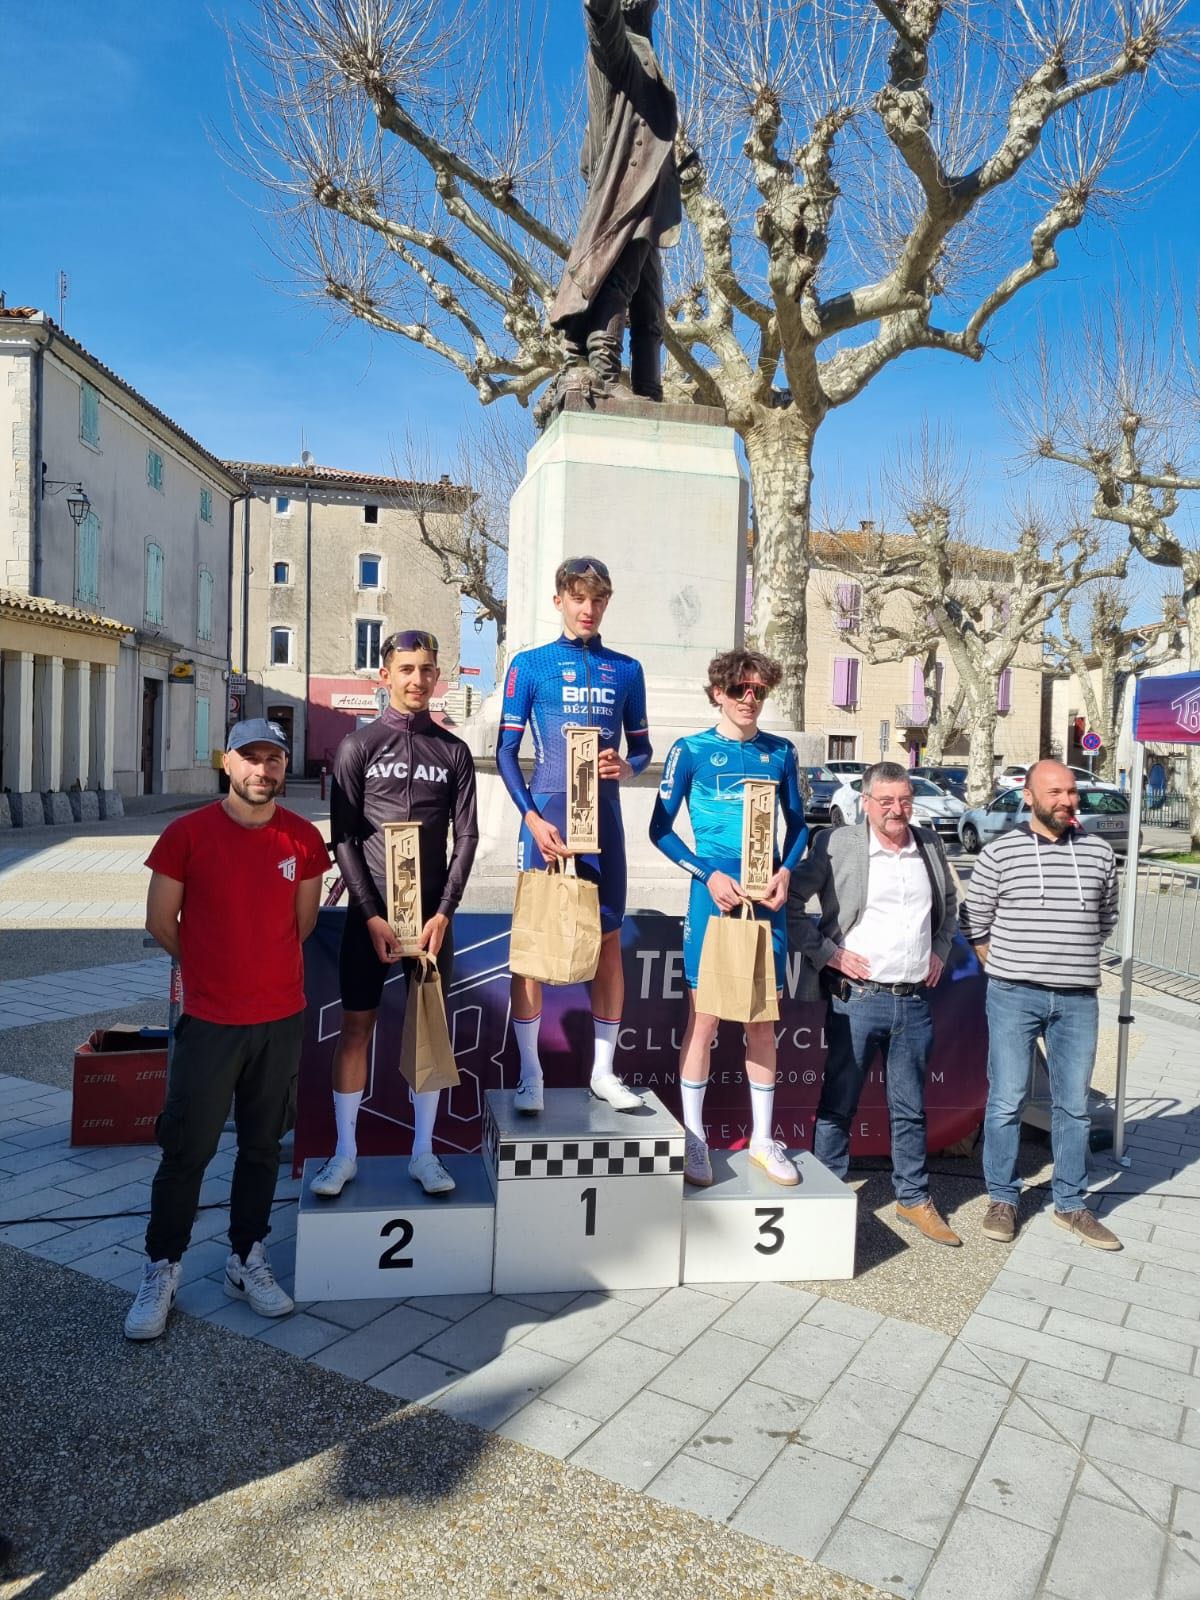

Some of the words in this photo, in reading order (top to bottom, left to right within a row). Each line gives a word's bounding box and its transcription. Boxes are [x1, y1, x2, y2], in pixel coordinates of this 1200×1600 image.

[338, 695, 374, 706] Artisan
[562, 686, 616, 704] BMC
[563, 704, 614, 716] BÉZIERS
[365, 762, 408, 779] AVC
[413, 764, 449, 783] AIX
[580, 1187, 598, 1236] 1
[754, 1207, 786, 1256] 3
[378, 1218, 414, 1269] 2
